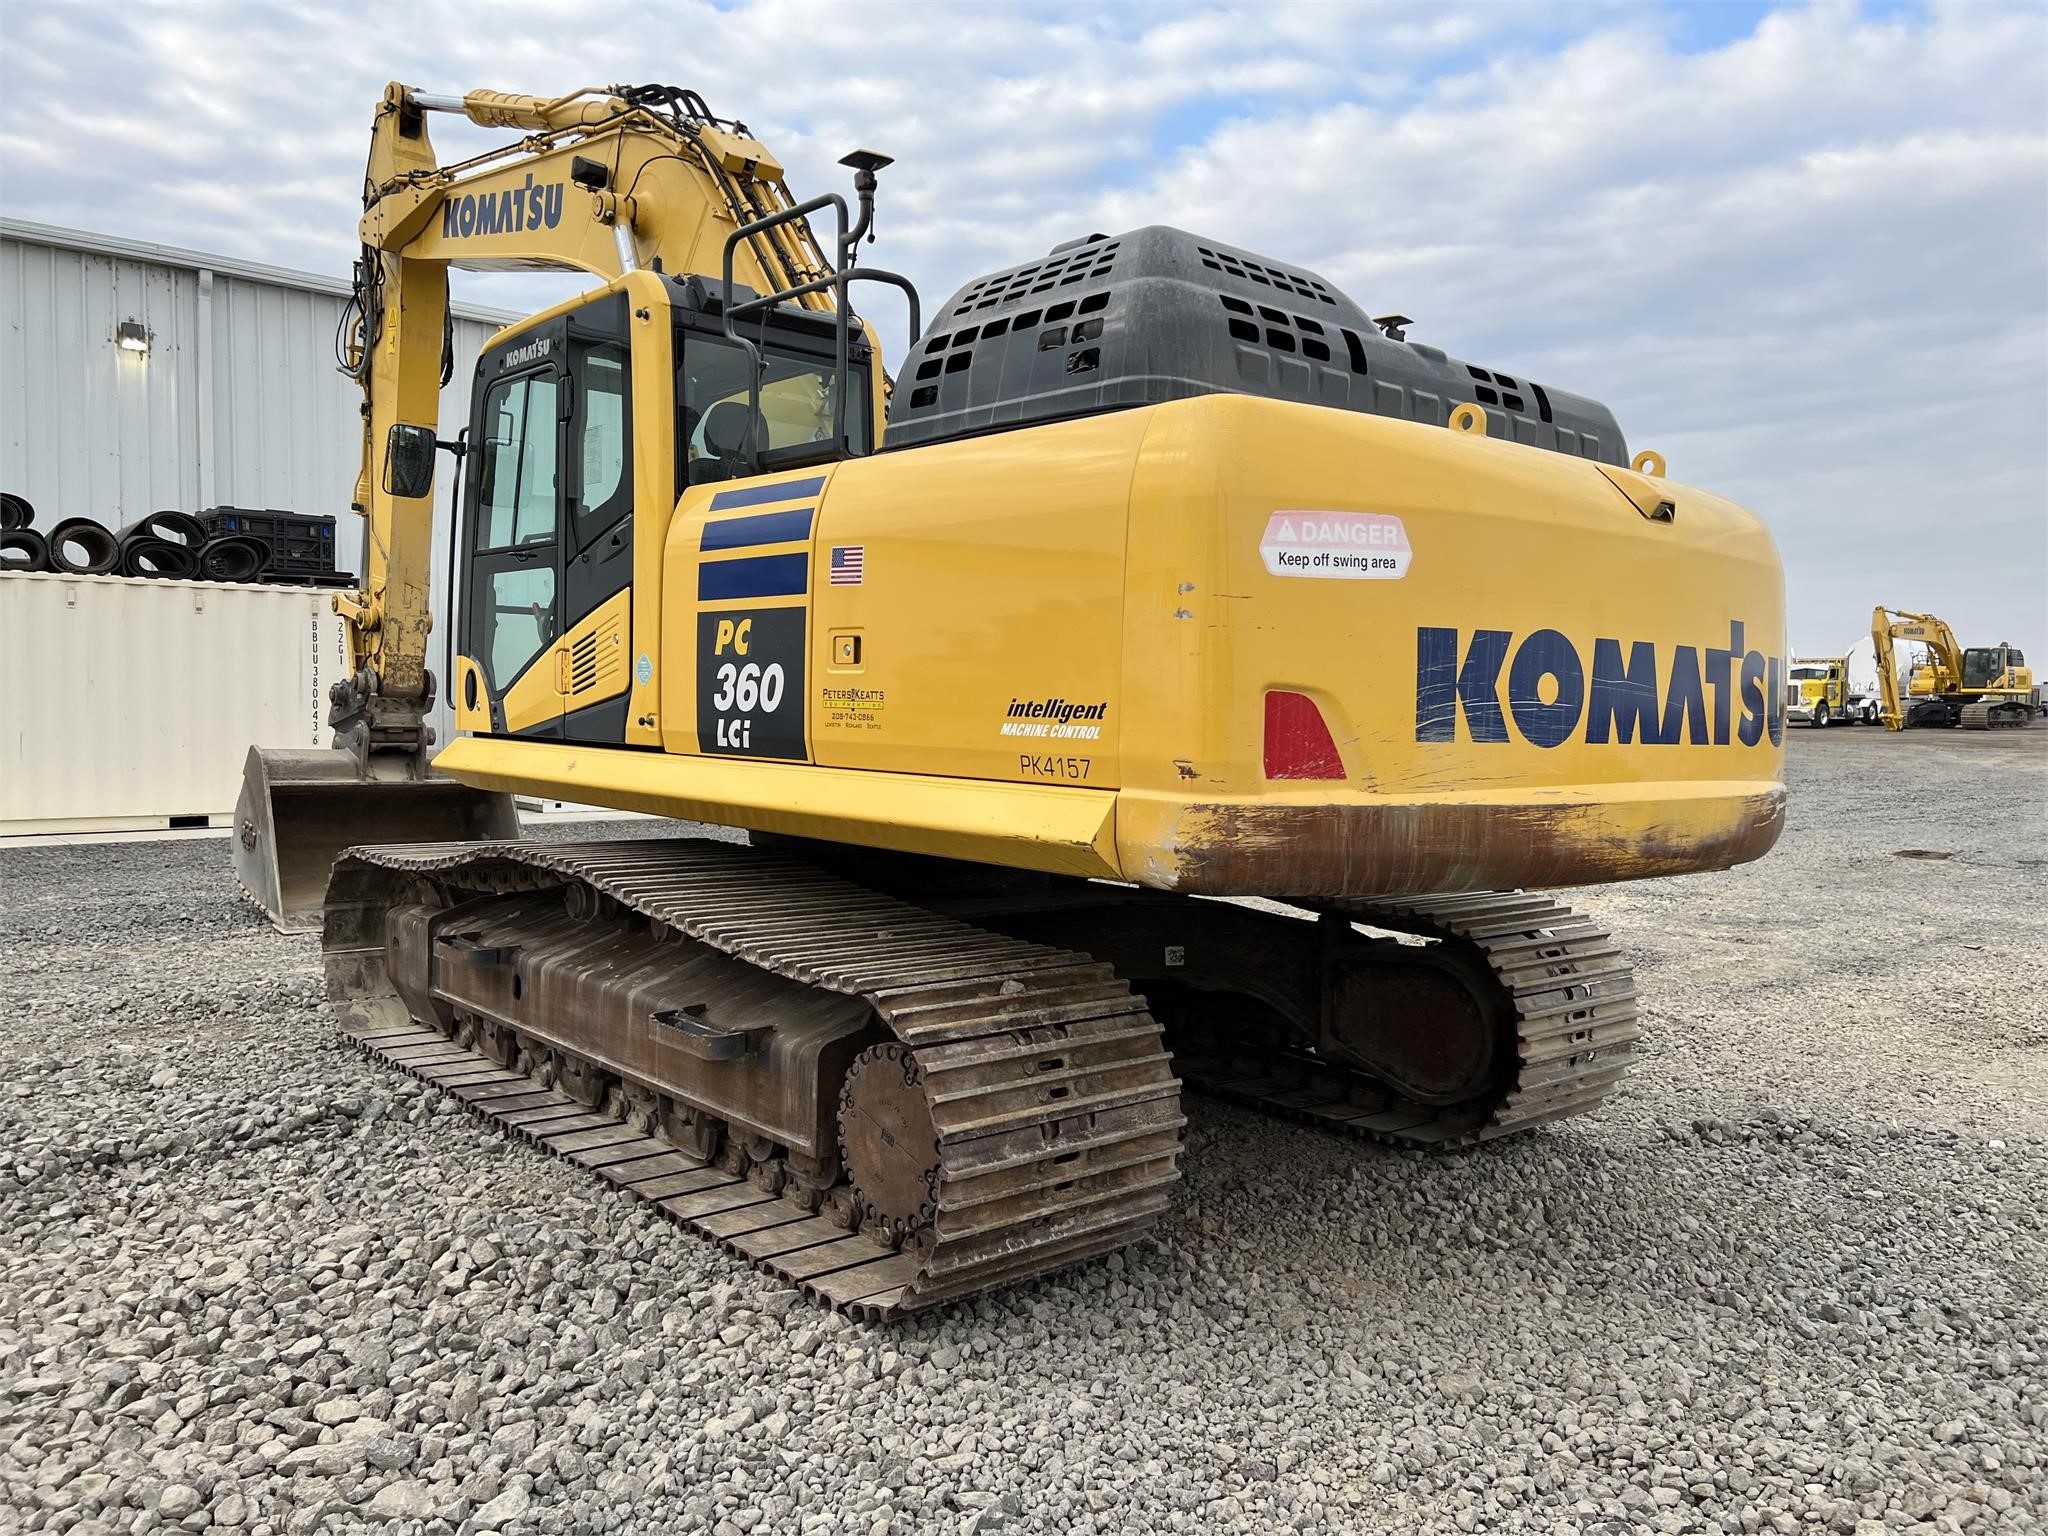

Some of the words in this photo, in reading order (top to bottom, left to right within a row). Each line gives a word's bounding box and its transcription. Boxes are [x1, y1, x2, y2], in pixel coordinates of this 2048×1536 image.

[443, 173, 564, 239] KOMATSU
[506, 338, 551, 368] KOMATSU
[1302, 521, 1397, 545] DANGER
[1279, 552, 1310, 570] Keep
[1313, 553, 1329, 567] off
[1333, 554, 1367, 571] swing
[1371, 557, 1396, 569] area
[714, 618, 752, 656] PC
[714, 663, 785, 713] 360
[1416, 620, 1784, 748] KOMATSU
[1007, 698, 1107, 724] intelligent
[717, 719, 751, 749] LCi
[1000, 722, 1050, 737] MACHINE
[1050, 724, 1100, 740] CONTROL
[1020, 755, 1090, 779] PK4157
